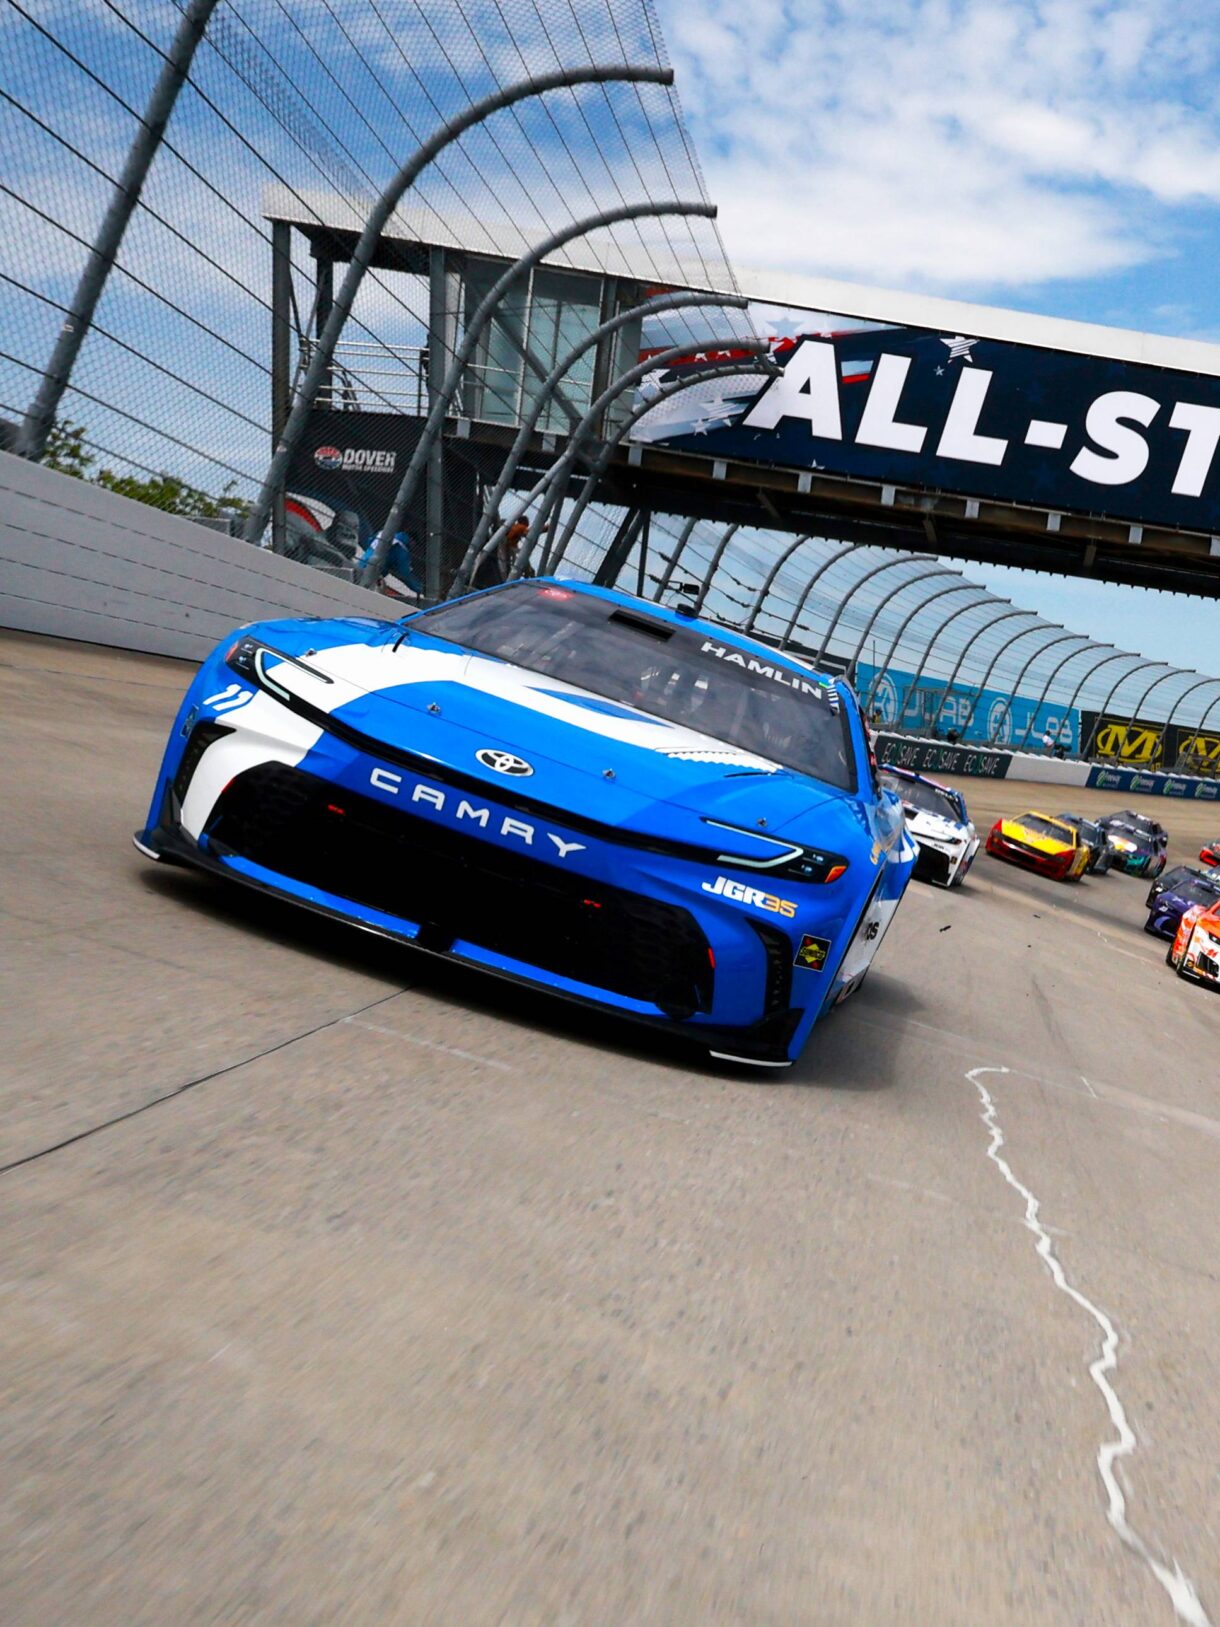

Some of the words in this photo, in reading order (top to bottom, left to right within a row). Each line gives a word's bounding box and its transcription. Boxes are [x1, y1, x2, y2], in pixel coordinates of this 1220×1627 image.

[343, 448, 397, 467] DOVER
[701, 642, 822, 700] HAMLIN
[370, 767, 587, 858] CAMRY
[701, 875, 799, 918] JGR35
